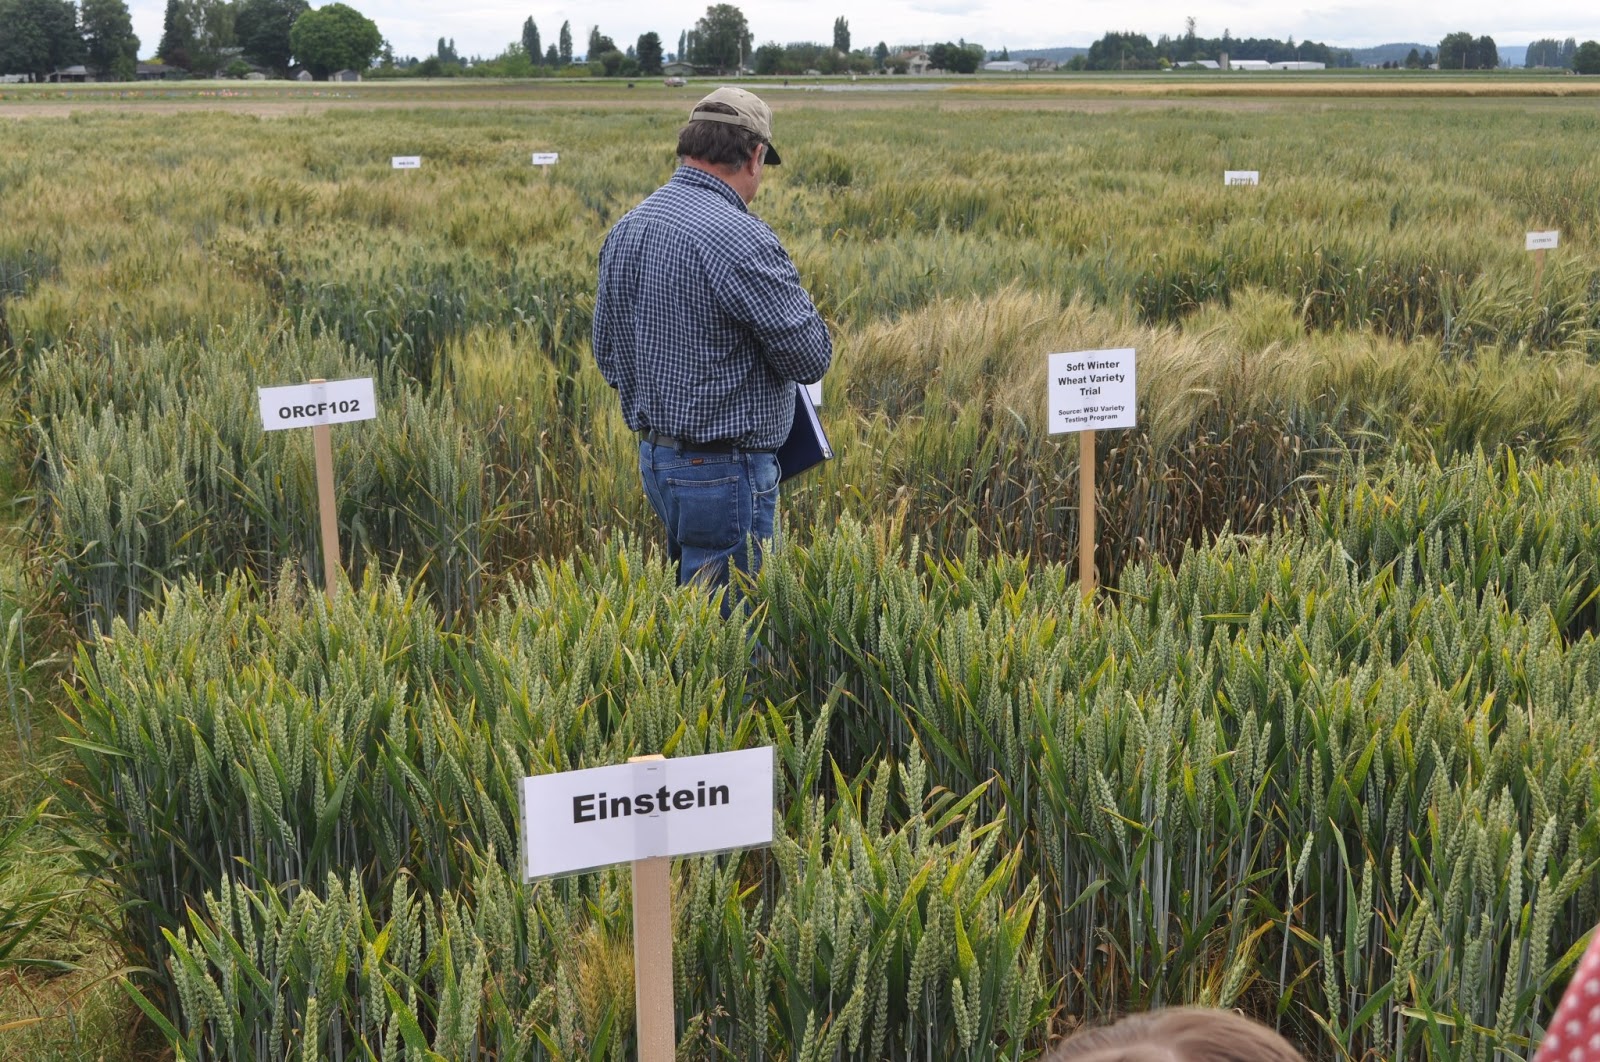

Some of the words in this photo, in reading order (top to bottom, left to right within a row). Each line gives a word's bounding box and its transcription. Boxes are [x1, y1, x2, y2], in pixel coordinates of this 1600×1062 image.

[1066, 362, 1085, 372] Soft
[1087, 361, 1120, 370] Winter
[1058, 376, 1087, 386] Wheat
[1090, 373, 1125, 383] Variety
[1080, 387, 1101, 396] Trial
[279, 399, 360, 419] ORCF102
[1058, 408, 1082, 416] Source:
[1100, 404, 1125, 412] Variety
[1065, 415, 1088, 423] Testing
[1089, 414, 1118, 422] Program
[572, 780, 730, 824] Einstein
